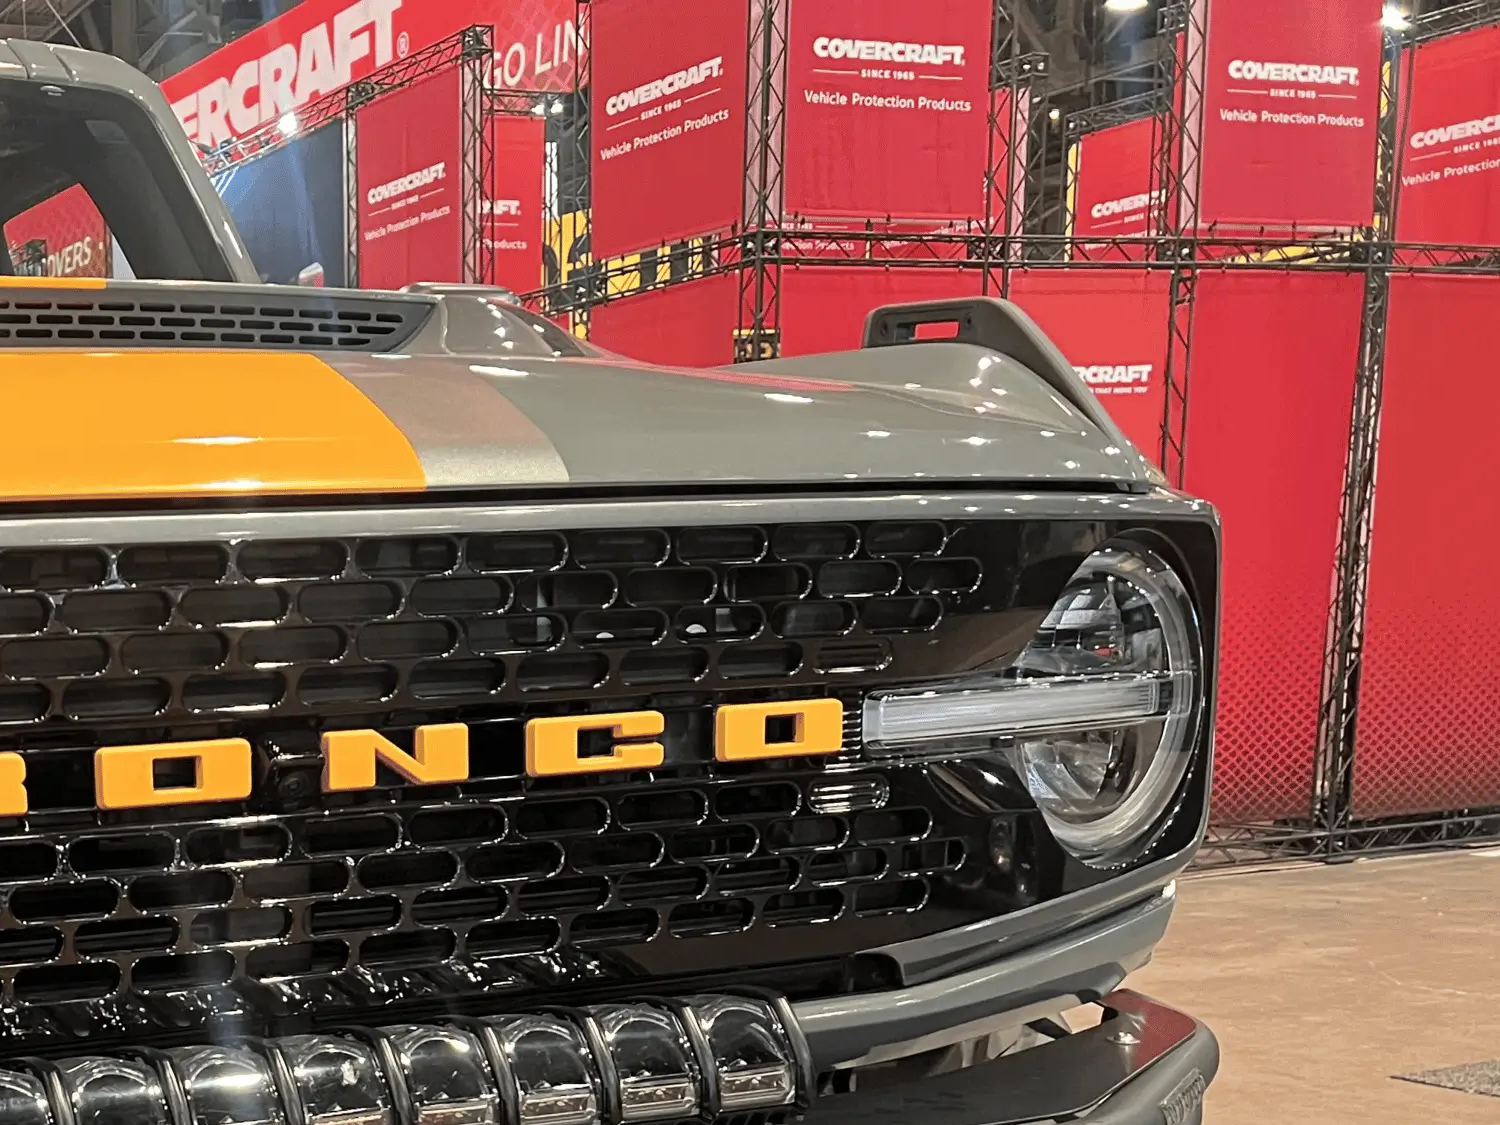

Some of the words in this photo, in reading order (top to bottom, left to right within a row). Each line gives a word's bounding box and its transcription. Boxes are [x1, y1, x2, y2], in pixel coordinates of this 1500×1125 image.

[813, 37, 964, 65] COVERCRAFT
[861, 69, 890, 78] SINCE
[1228, 60, 1359, 85] COVERCRAFT
[606, 56, 723, 116] COVERCRAFT
[804, 90, 847, 105] Vehicle
[852, 93, 914, 108] Protection
[918, 97, 971, 112] Products
[641, 106, 662, 121] SINCE
[1220, 108, 1257, 122] Vehicle
[1261, 110, 1315, 124] Protection
[1318, 113, 1364, 127] Products
[600, 142, 632, 160] Vehicle
[633, 125, 682, 149] Protection
[684, 109, 729, 133] Products
[367, 162, 445, 204] COVERCRAFT
[1402, 170, 1440, 186] Vehicle
